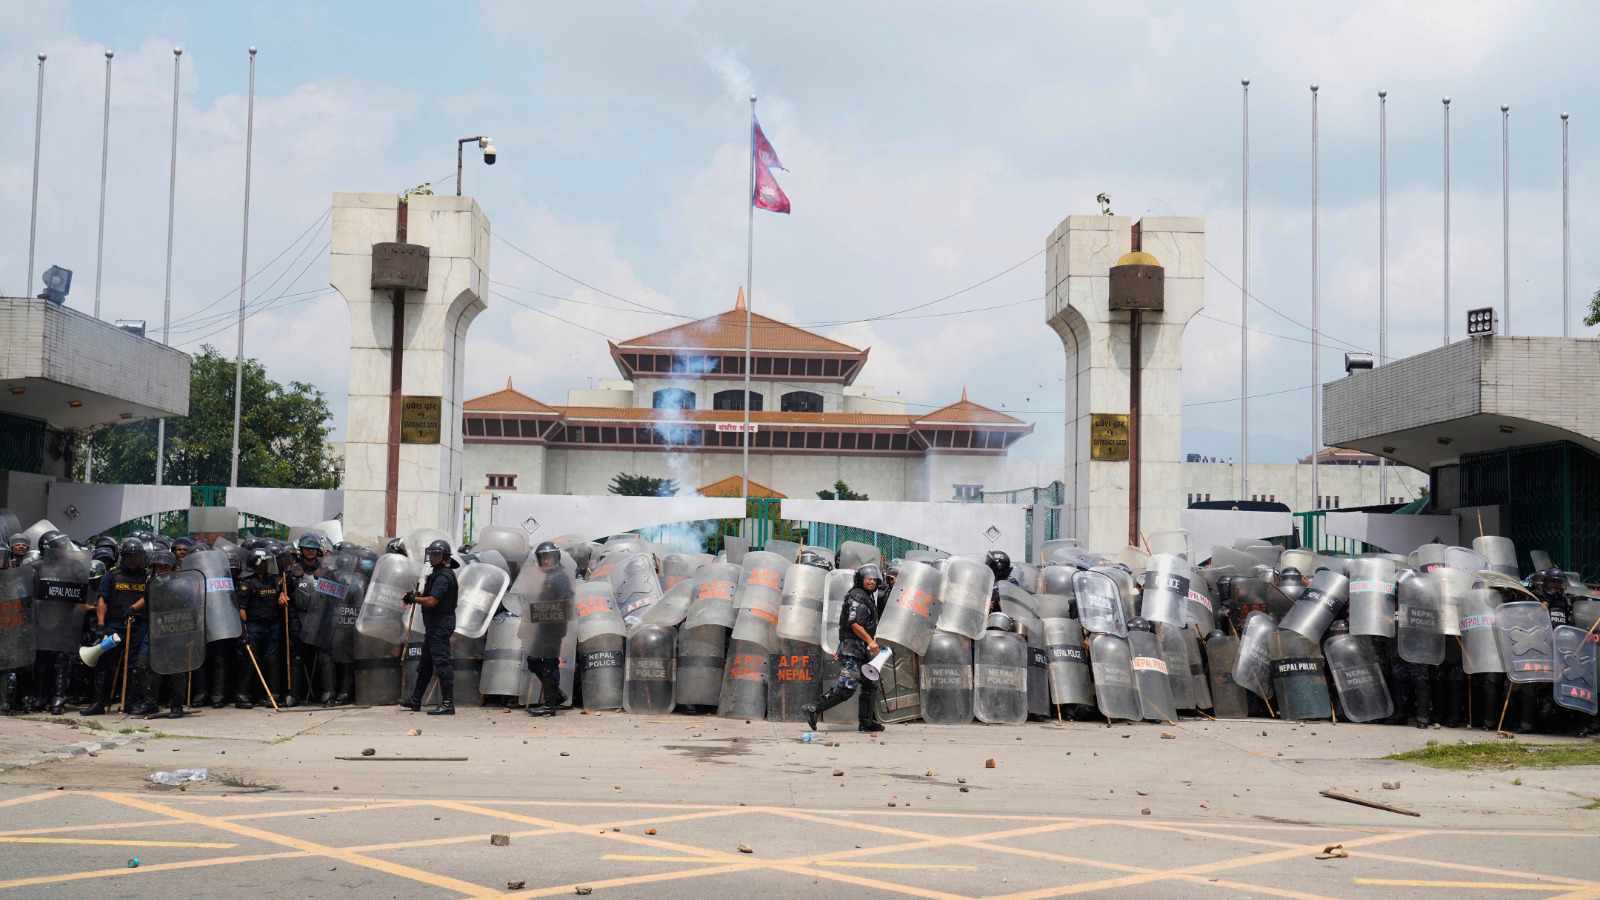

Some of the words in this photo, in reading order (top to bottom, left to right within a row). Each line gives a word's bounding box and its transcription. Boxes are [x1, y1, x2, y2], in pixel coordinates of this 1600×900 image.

[48, 586, 64, 597] NEPAL
[64, 587, 81, 598] POLICE
[588, 651, 615, 660] NEPAL
[588, 660, 617, 668] POLICE
[1279, 663, 1298, 672] NEPAL
[1298, 662, 1318, 671] POLICE
[777, 669, 812, 681] NEPAL
